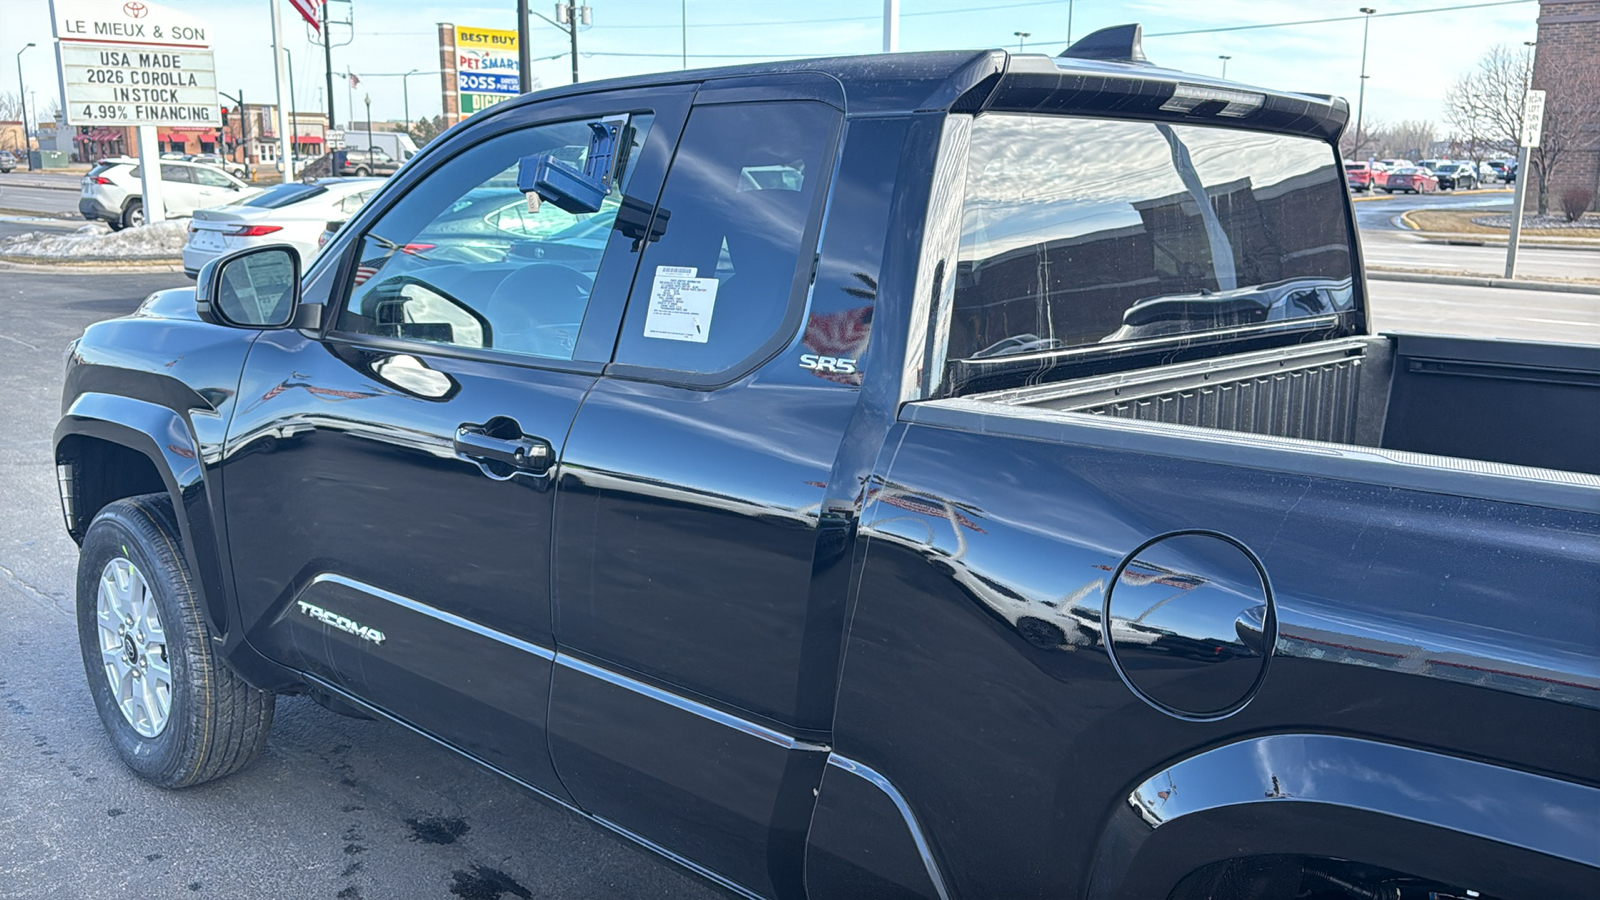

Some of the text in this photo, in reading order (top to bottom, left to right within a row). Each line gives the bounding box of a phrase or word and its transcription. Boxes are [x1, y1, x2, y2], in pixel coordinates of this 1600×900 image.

[65, 20, 205, 41] LE MIEUX & SON
[461, 32, 516, 45] BEST BUY
[100, 52, 181, 69] USA MADE
[87, 69, 198, 87] 2026 COROLLA
[460, 75, 496, 90] ROSS
[83, 105, 210, 121] 4.99% FINANCING
[798, 353, 857, 374] SR5
[297, 600, 387, 646] TACOMA
